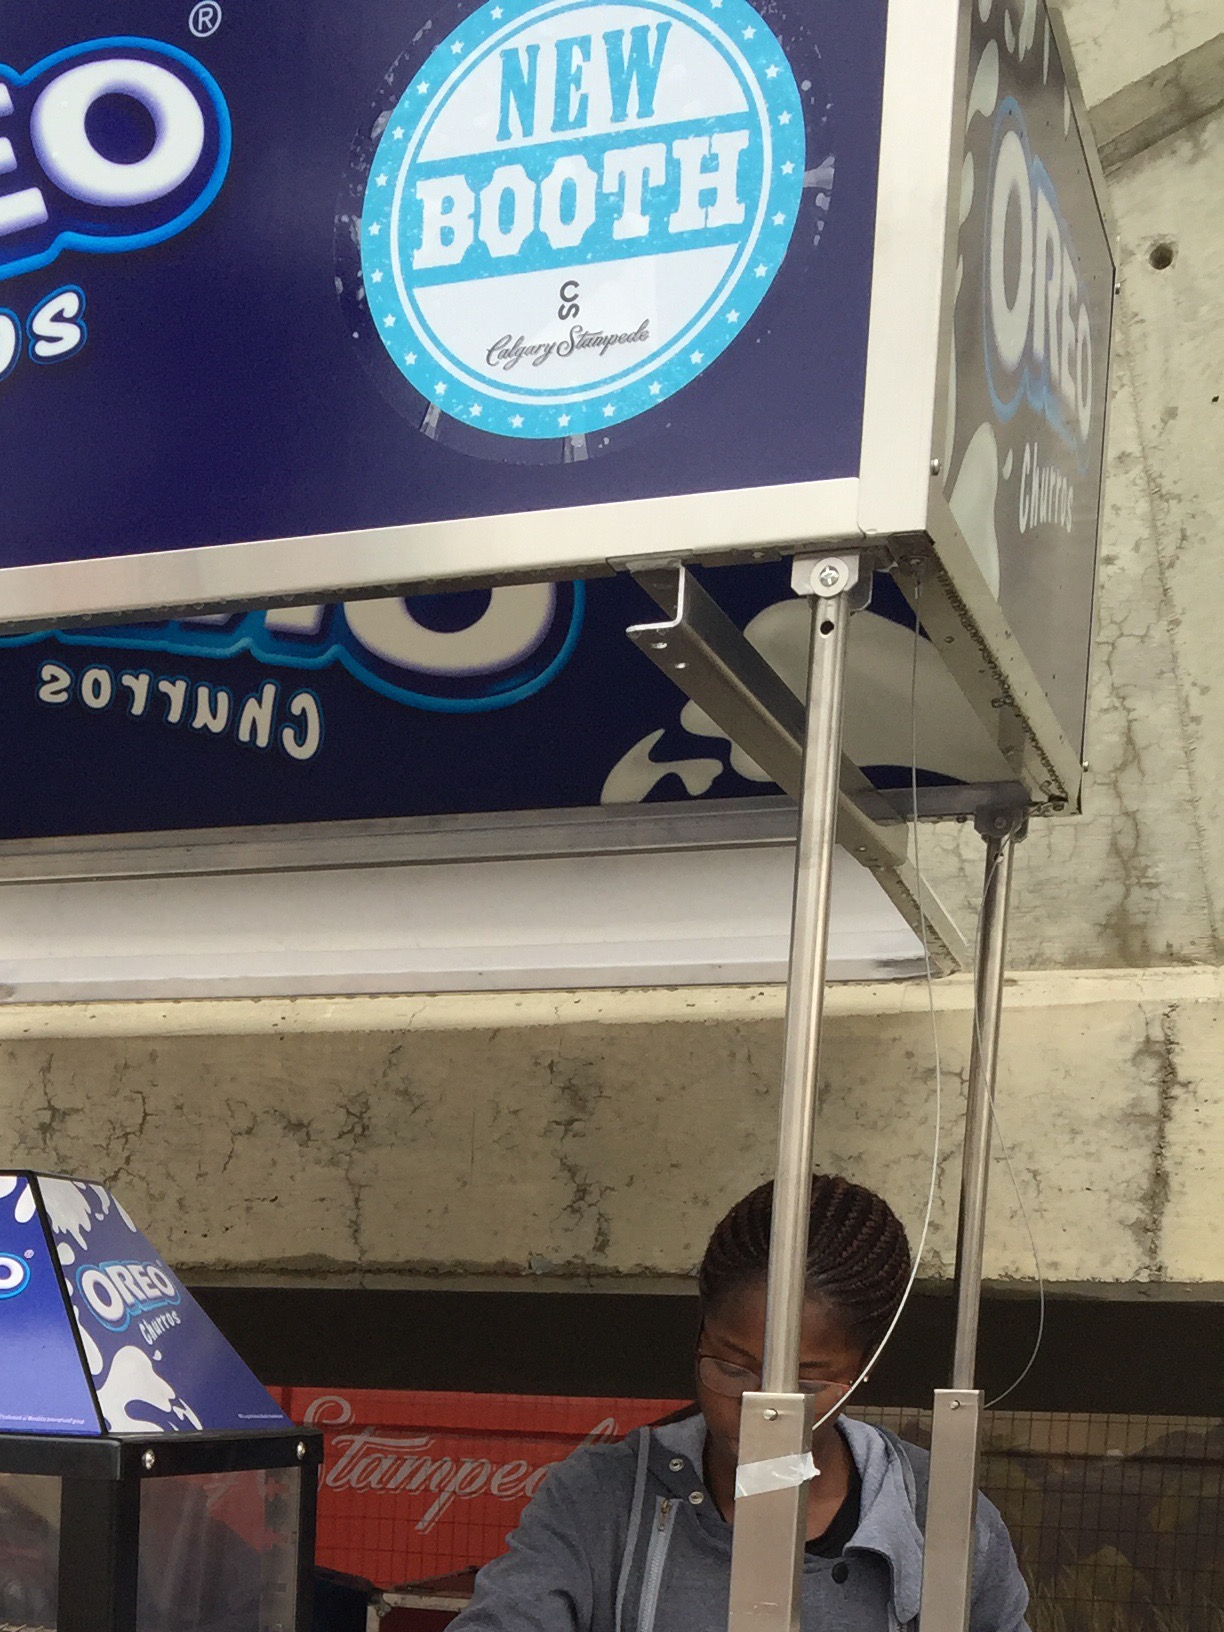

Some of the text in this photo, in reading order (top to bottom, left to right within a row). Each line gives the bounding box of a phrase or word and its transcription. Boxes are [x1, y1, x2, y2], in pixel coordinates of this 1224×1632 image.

[495, 21, 673, 142] NEW
[412, 129, 750, 270] BOOTH
[989, 129, 1093, 443] OREO
[485, 318, 651, 371] Calgary Stampede
[1018, 441, 1074, 535] Churros
[81, 1264, 176, 1322] OREO
[138, 1310, 182, 1346] Churros
